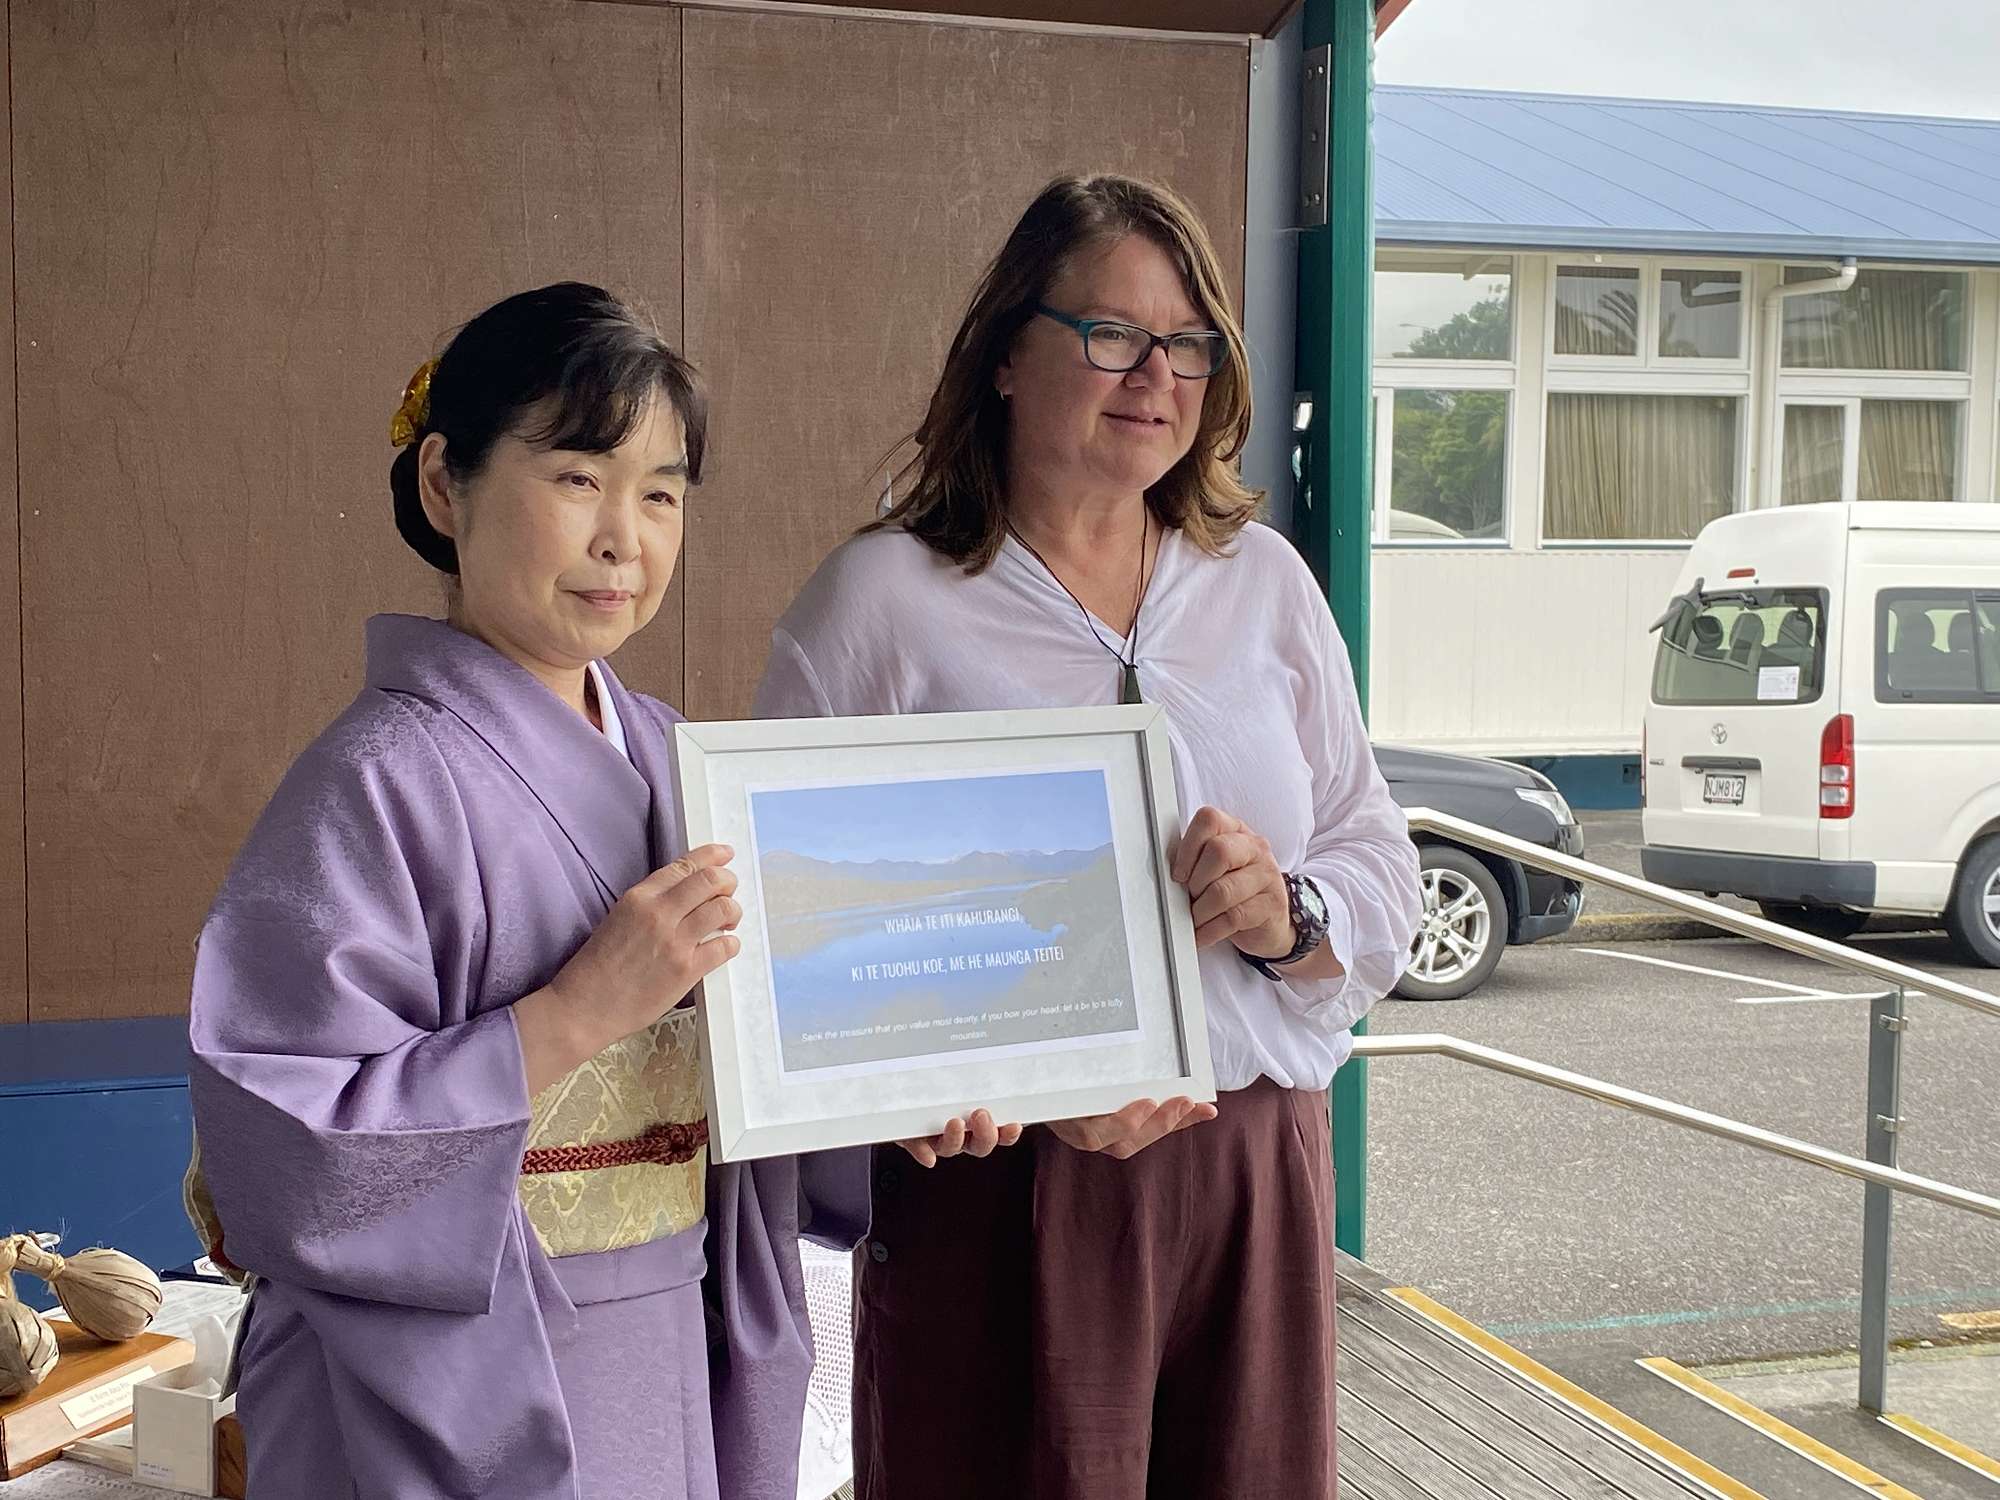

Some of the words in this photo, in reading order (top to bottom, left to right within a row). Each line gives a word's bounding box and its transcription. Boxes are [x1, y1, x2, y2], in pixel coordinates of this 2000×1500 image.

[1705, 780, 1743, 798] NJM812
[924, 914, 938, 930] TE
[940, 912, 954, 929] ITI
[851, 966, 863, 982] KI
[865, 964, 879, 981] TE
[881, 960, 920, 979] TUOHU
[922, 957, 948, 975] KOE,
[949, 955, 966, 971] ME
[967, 953, 983, 970] HE
[984, 949, 1032, 969] MAUNGA
[1033, 945, 1065, 963] TEITEI
[824, 1031, 838, 1040] the
[875, 1023, 891, 1034] that
[893, 1024, 908, 1034] you
[932, 1017, 952, 1027] most
[987, 1012, 1003, 1023] you
[1021, 1008, 1039, 1020] your
